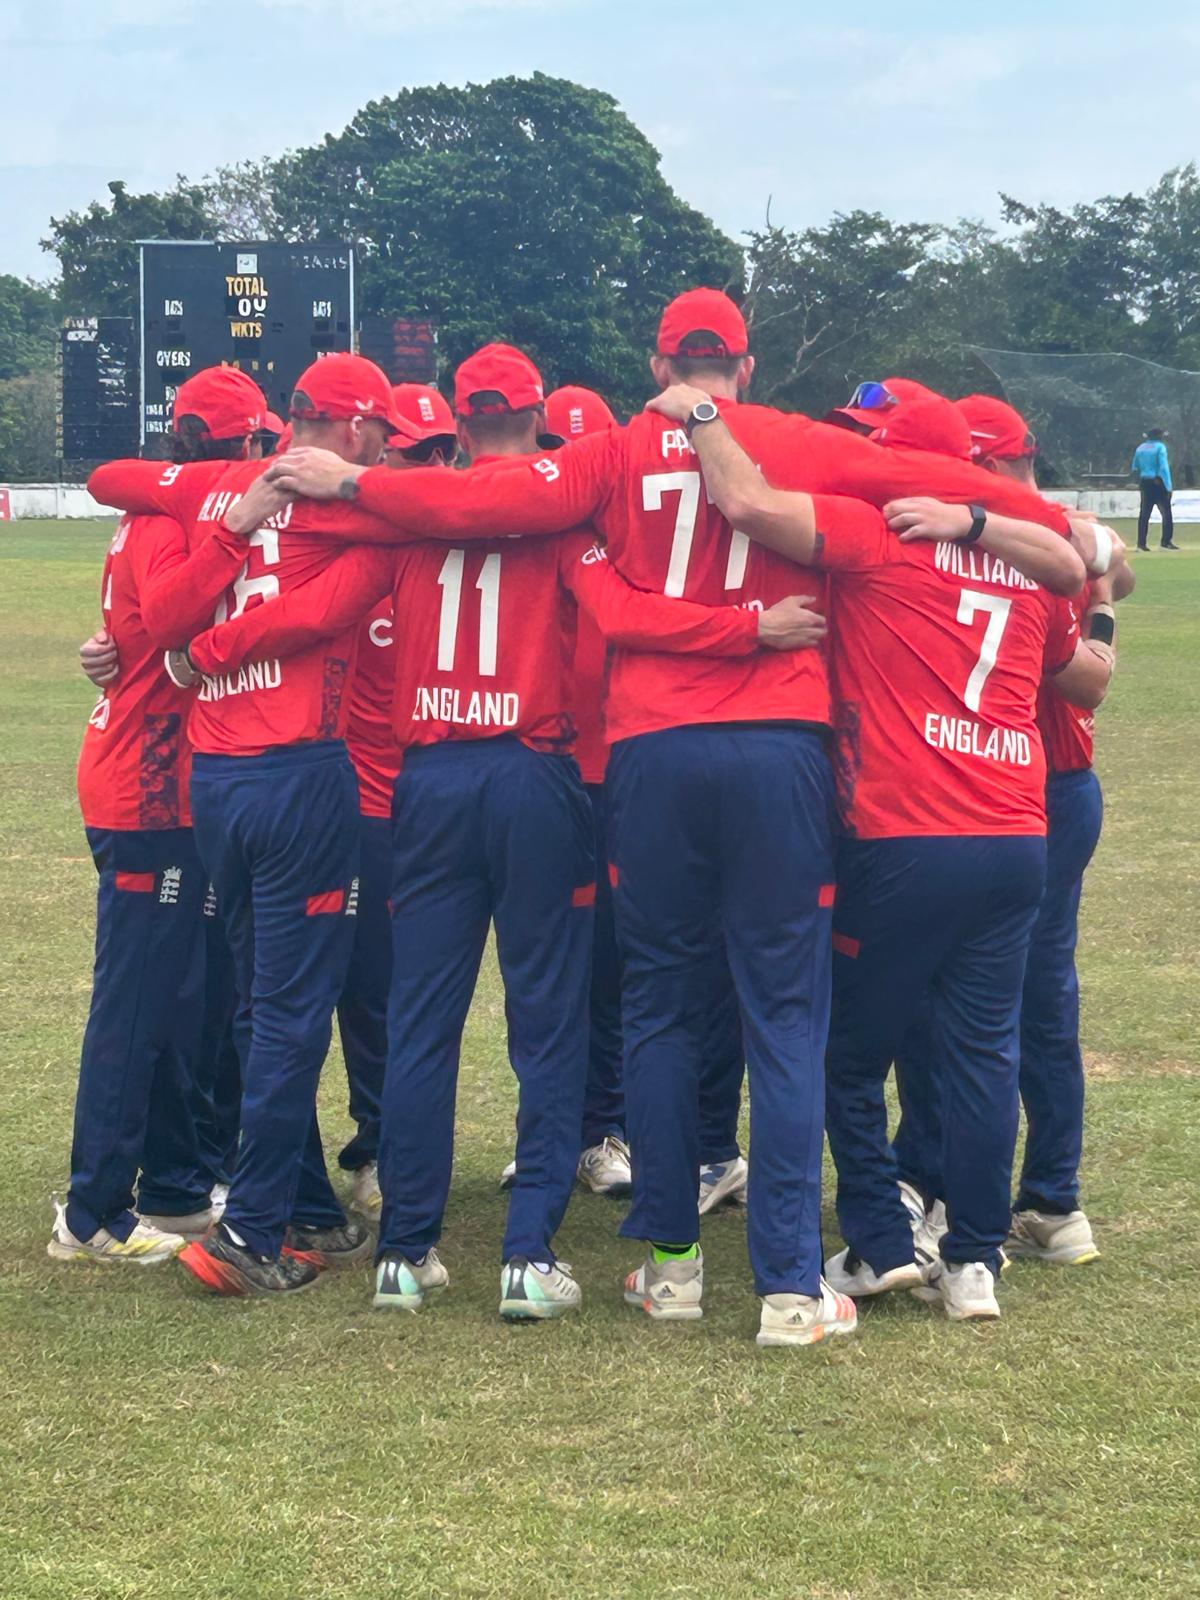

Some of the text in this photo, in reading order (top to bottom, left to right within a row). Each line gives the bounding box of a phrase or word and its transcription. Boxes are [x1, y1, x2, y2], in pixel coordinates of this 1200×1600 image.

[225, 276, 268, 297] TOTAL
[230, 321, 262, 338] WKTS
[437, 548, 501, 677] 11
[956, 588, 1012, 713] 7
[924, 713, 1031, 766] ENGLAND
